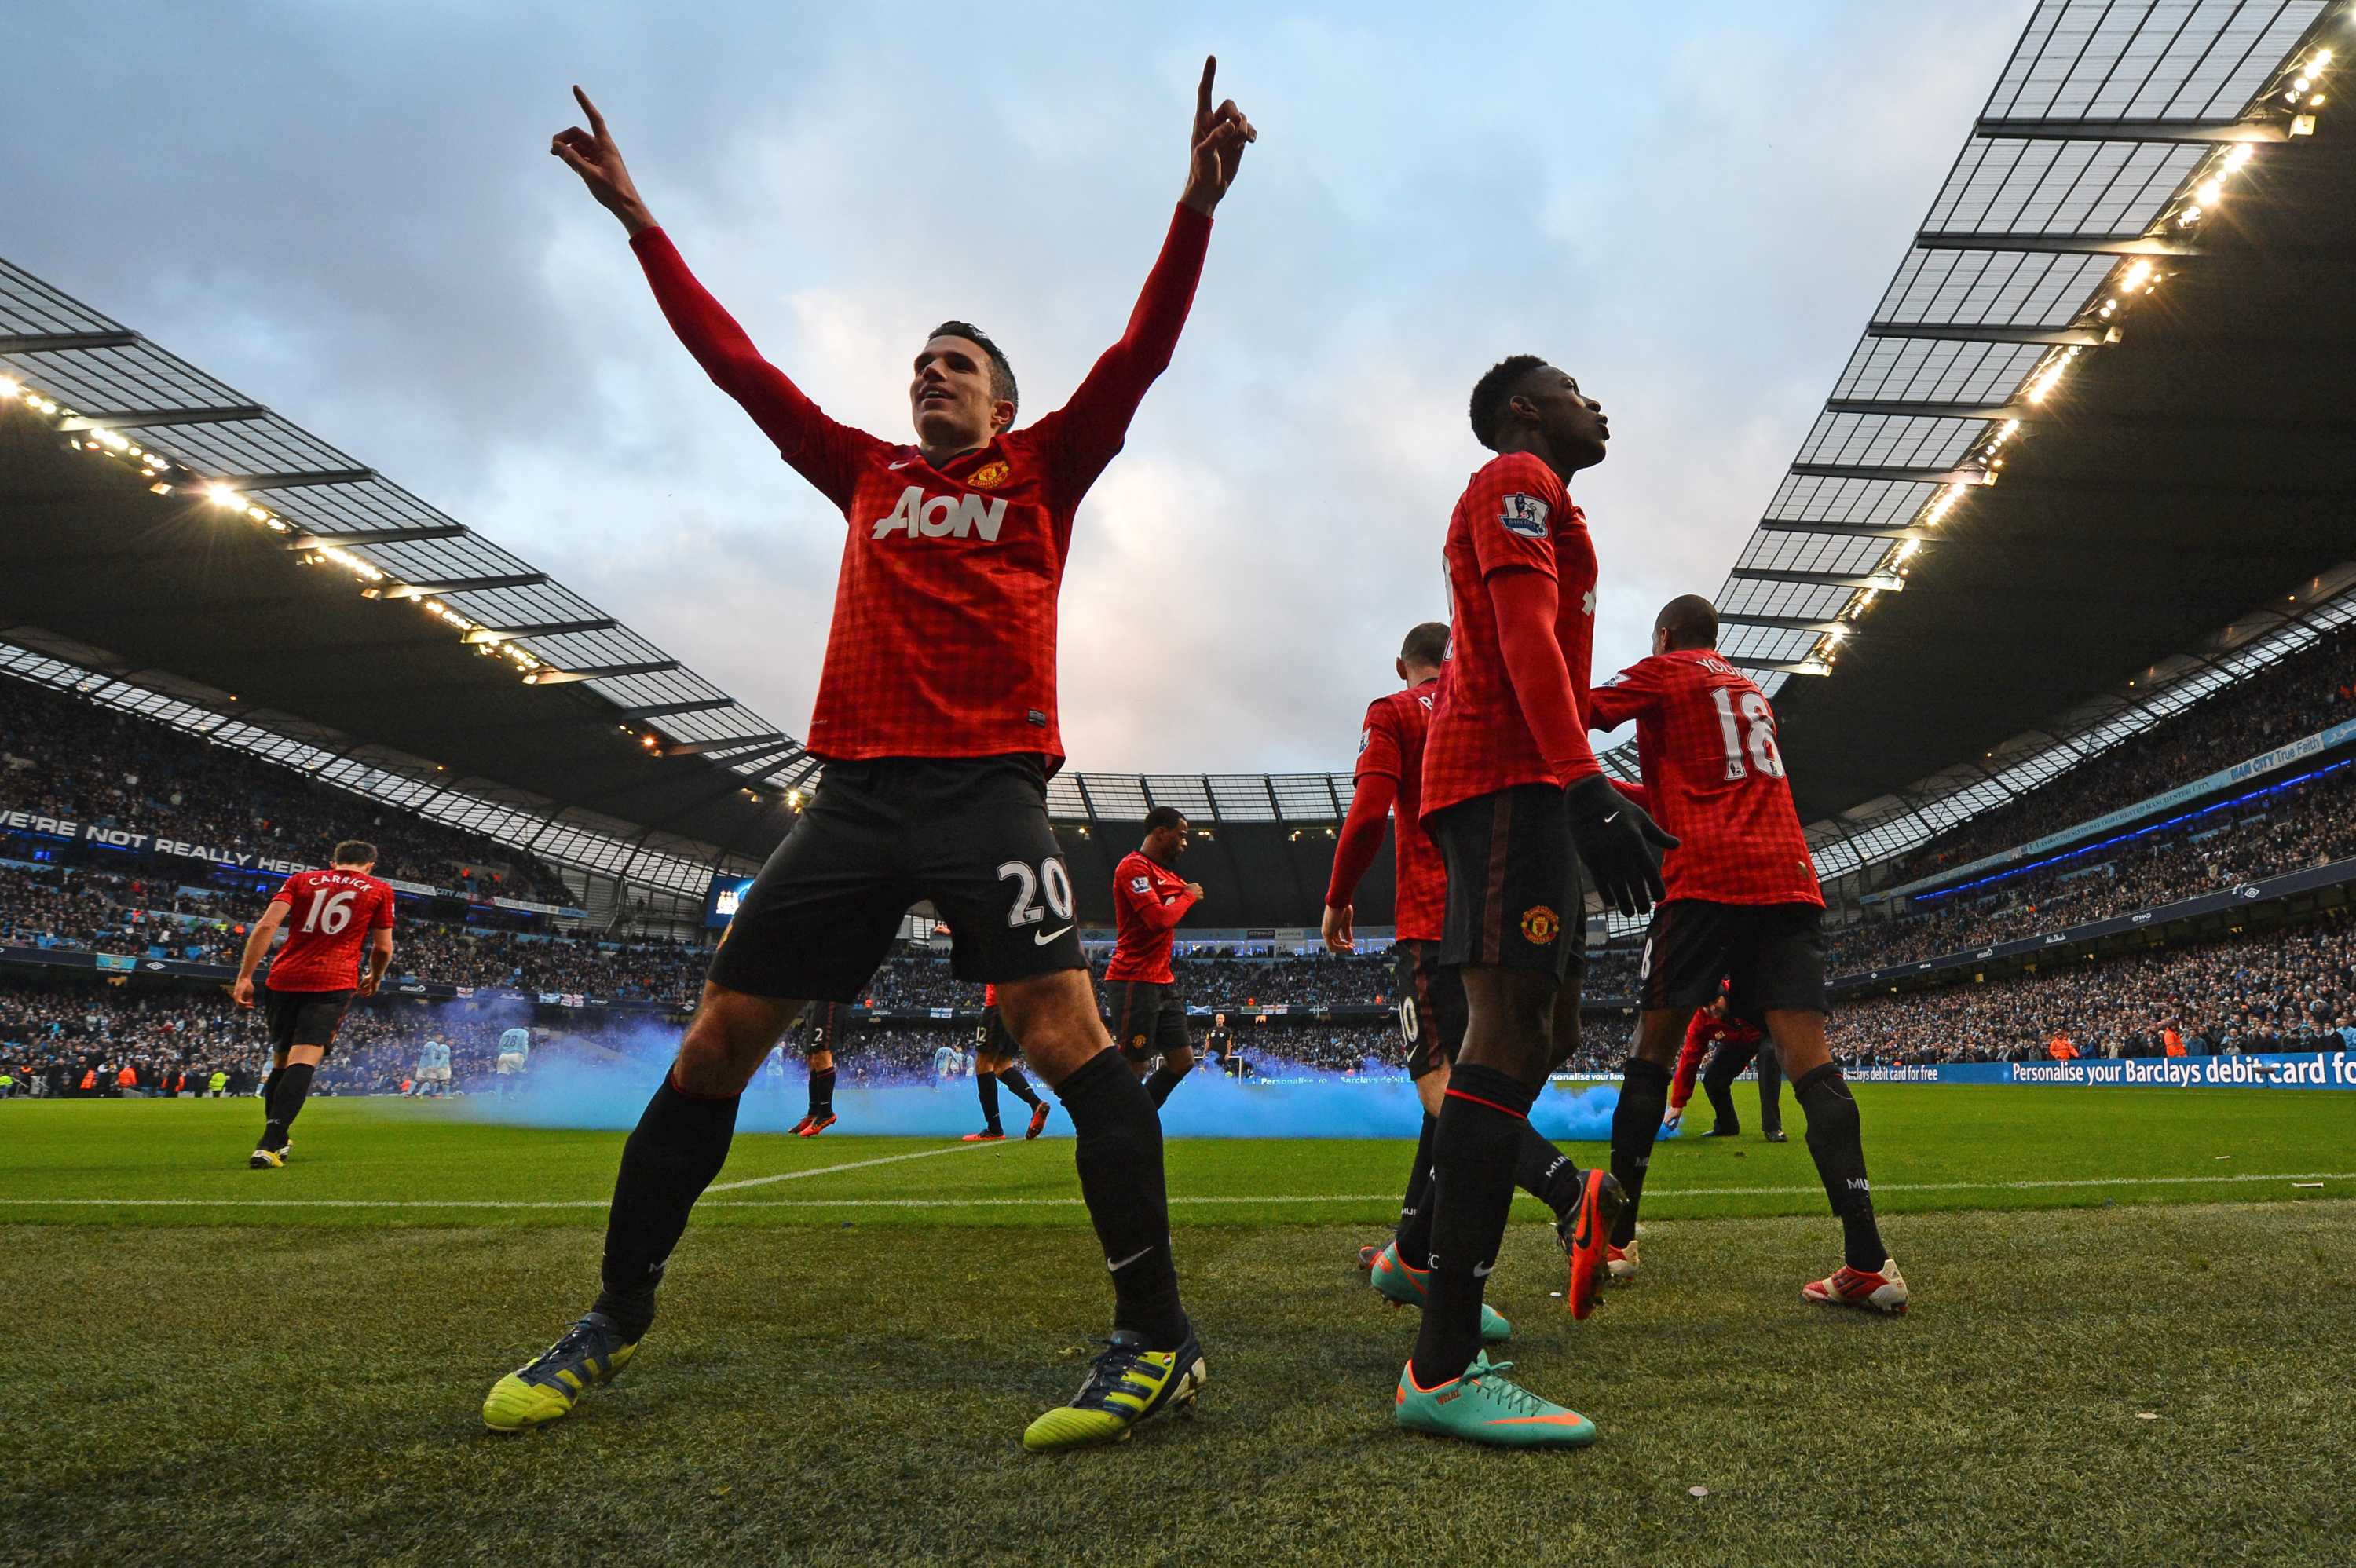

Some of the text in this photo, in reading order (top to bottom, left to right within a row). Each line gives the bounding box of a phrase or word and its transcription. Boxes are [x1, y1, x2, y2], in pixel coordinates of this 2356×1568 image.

[872, 486, 1008, 542] AON
[1710, 686, 1786, 780] 18
[2277, 750, 2295, 763] True
[2296, 736, 2320, 755] Faith
[86, 826, 148, 848] NOT
[154, 838, 252, 867] REALLY
[309, 875, 374, 892] CARRICK
[997, 857, 1074, 928] 20
[300, 887, 357, 935] 16
[814, 1027, 823, 1042] 2
[975, 1026, 987, 1043] 12
[1398, 996, 1418, 1046] 10
[503, 1034, 517, 1047] 28
[1548, 1073, 1590, 1081] rsonalise
[1842, 1064, 1938, 1083] Barclays debit card for free
[2013, 1060, 2083, 1082] Personalise
[2087, 1065, 2122, 1086] your
[2125, 1058, 2201, 1087] Barclays
[2205, 1055, 2264, 1084] debit
[2268, 1052, 2327, 1084] card
